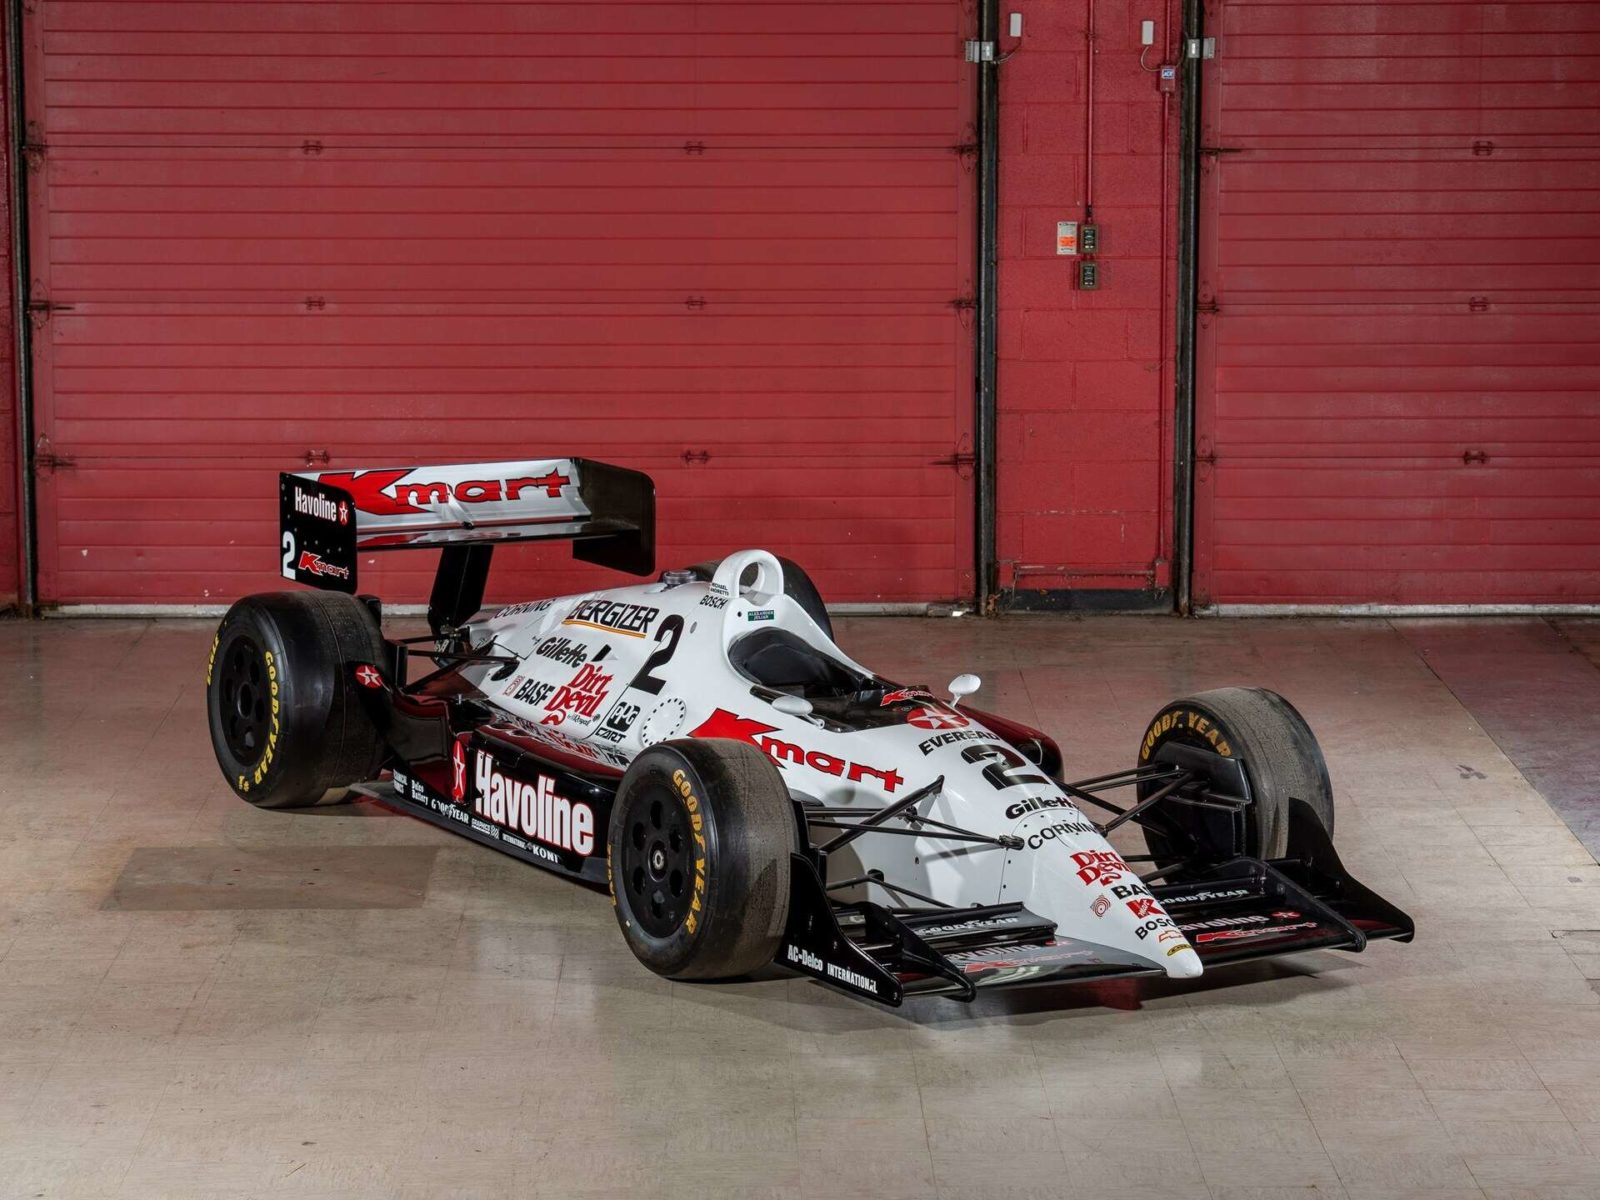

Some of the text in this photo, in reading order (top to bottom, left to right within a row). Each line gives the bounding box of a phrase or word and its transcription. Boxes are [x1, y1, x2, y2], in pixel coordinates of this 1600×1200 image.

[295, 486, 337, 522] Havoline
[318, 467, 571, 516] Kmart
[282, 531, 296, 581] 2
[298, 550, 350, 580] Kmart
[700, 595, 728, 610] BOSCH
[536, 636, 588, 669] Gillette
[629, 614, 685, 696] 2
[513, 678, 556, 706] BASF
[567, 663, 615, 696] Dirt
[544, 685, 609, 718] Devil
[606, 701, 641, 732] PPG
[595, 727, 627, 744] CART
[686, 707, 904, 793] Kmart
[918, 730, 1001, 757] EVEREAD
[961, 744, 1051, 791] 2
[475, 750, 594, 856] Havoline
[532, 843, 560, 864] KONI
[1111, 884, 1152, 899] BA
[1135, 918, 1178, 940] BOSC
[1178, 914, 1270, 932] avoline
[943, 943, 1042, 961] avoline
[787, 944, 879, 994] AC-Delco INTERNATIONAL
